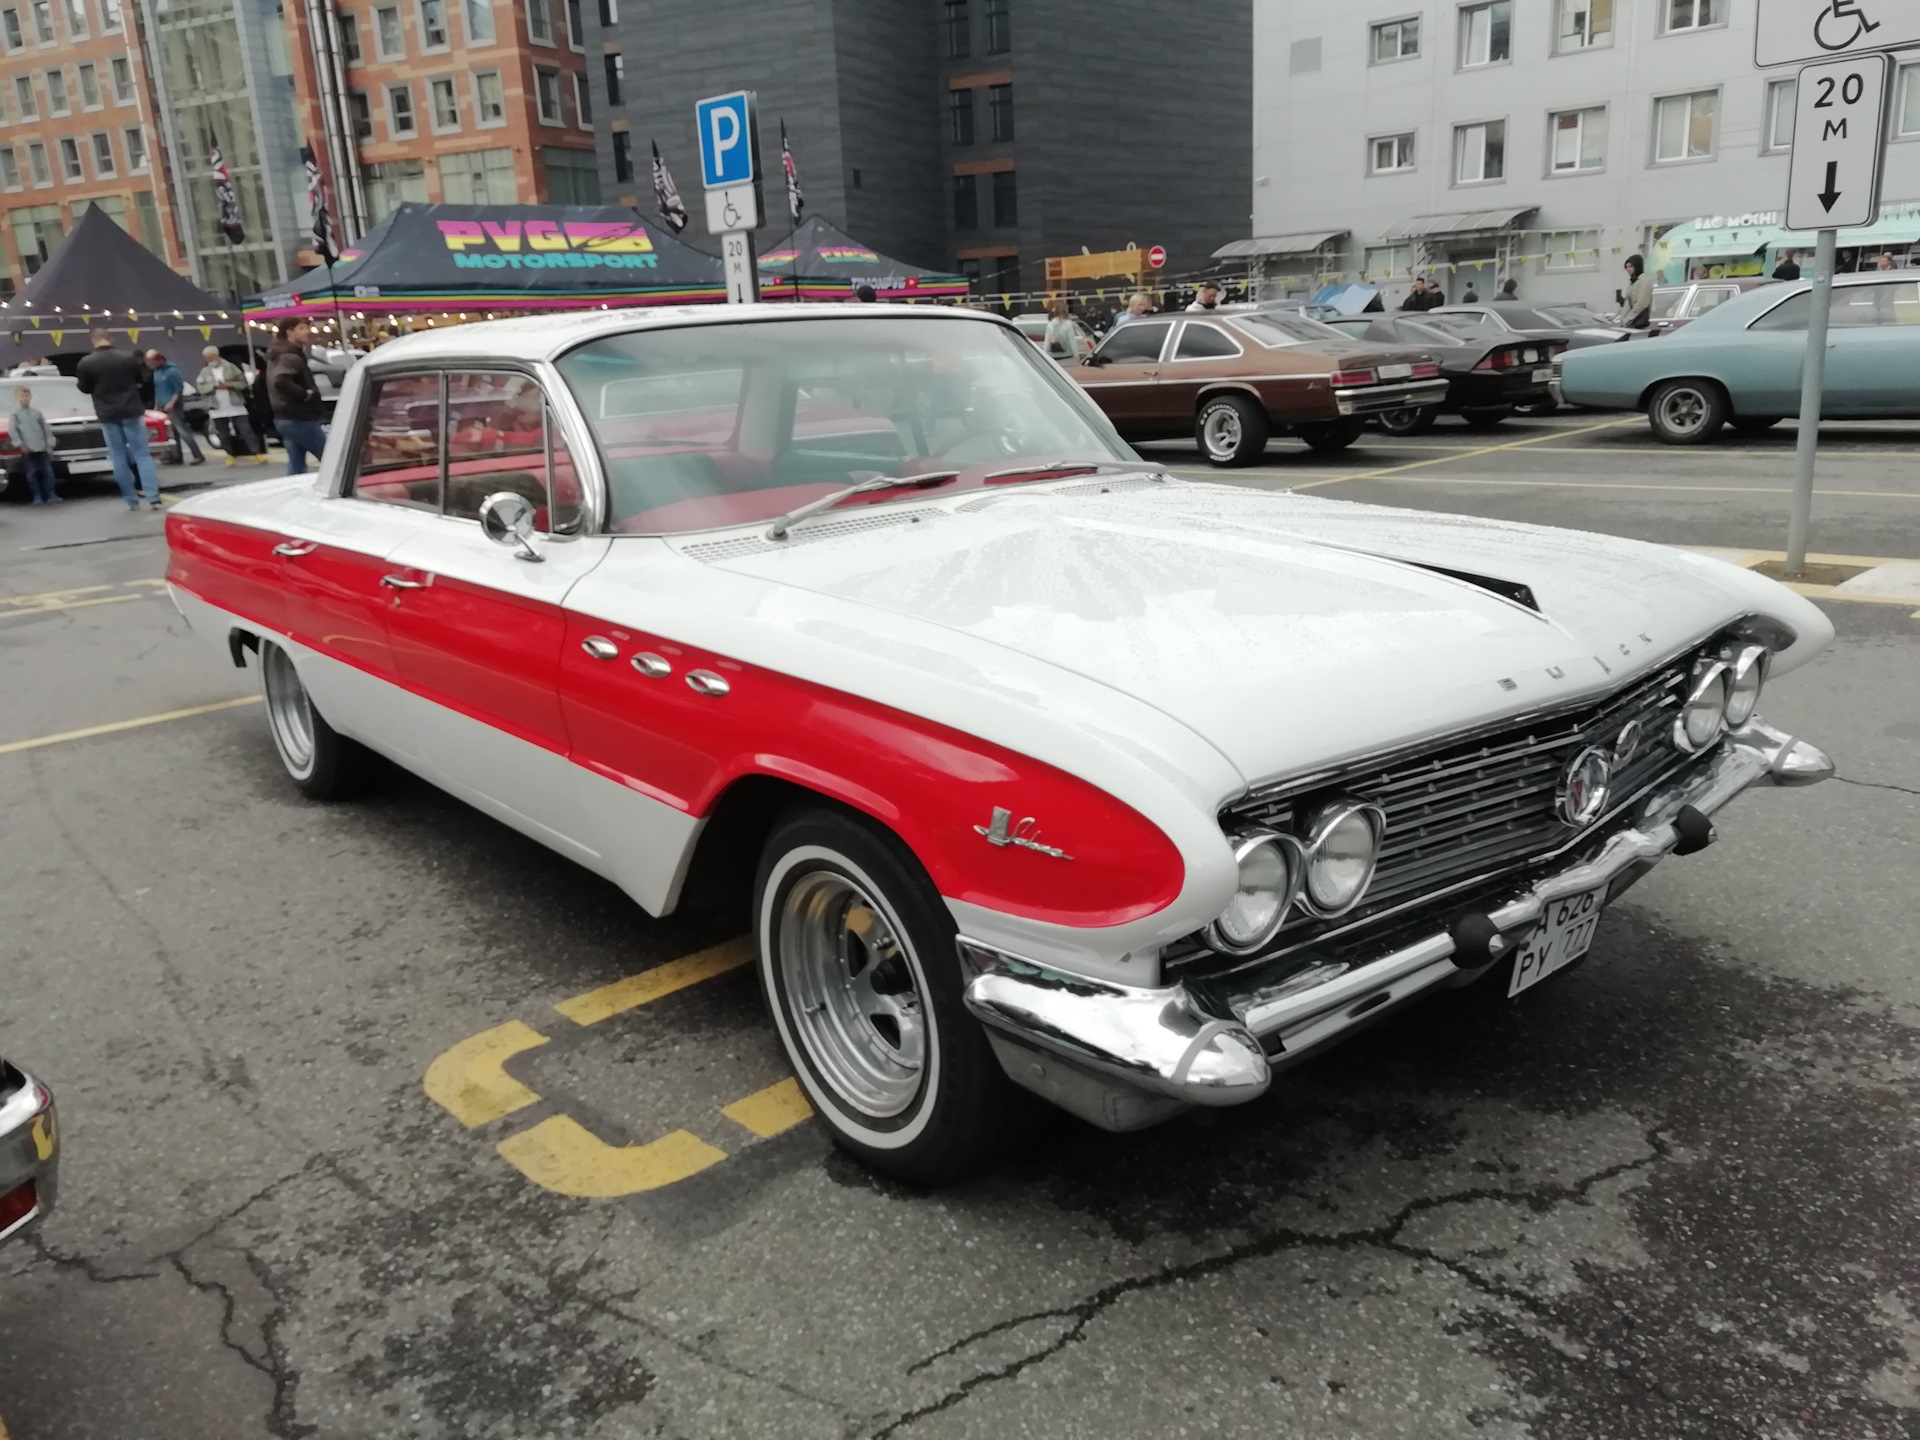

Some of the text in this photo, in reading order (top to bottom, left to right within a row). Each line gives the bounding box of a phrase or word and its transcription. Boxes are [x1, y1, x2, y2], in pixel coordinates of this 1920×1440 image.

[1814, 73, 1864, 108] 20
[710, 106, 740, 177] P
[1727, 211, 1778, 228] MOCHI
[453, 252, 658, 269] MOTORSPORT
[728, 241, 742, 257] 20
[1497, 632, 1653, 692] BUICK
[1563, 917, 1595, 954] 777
